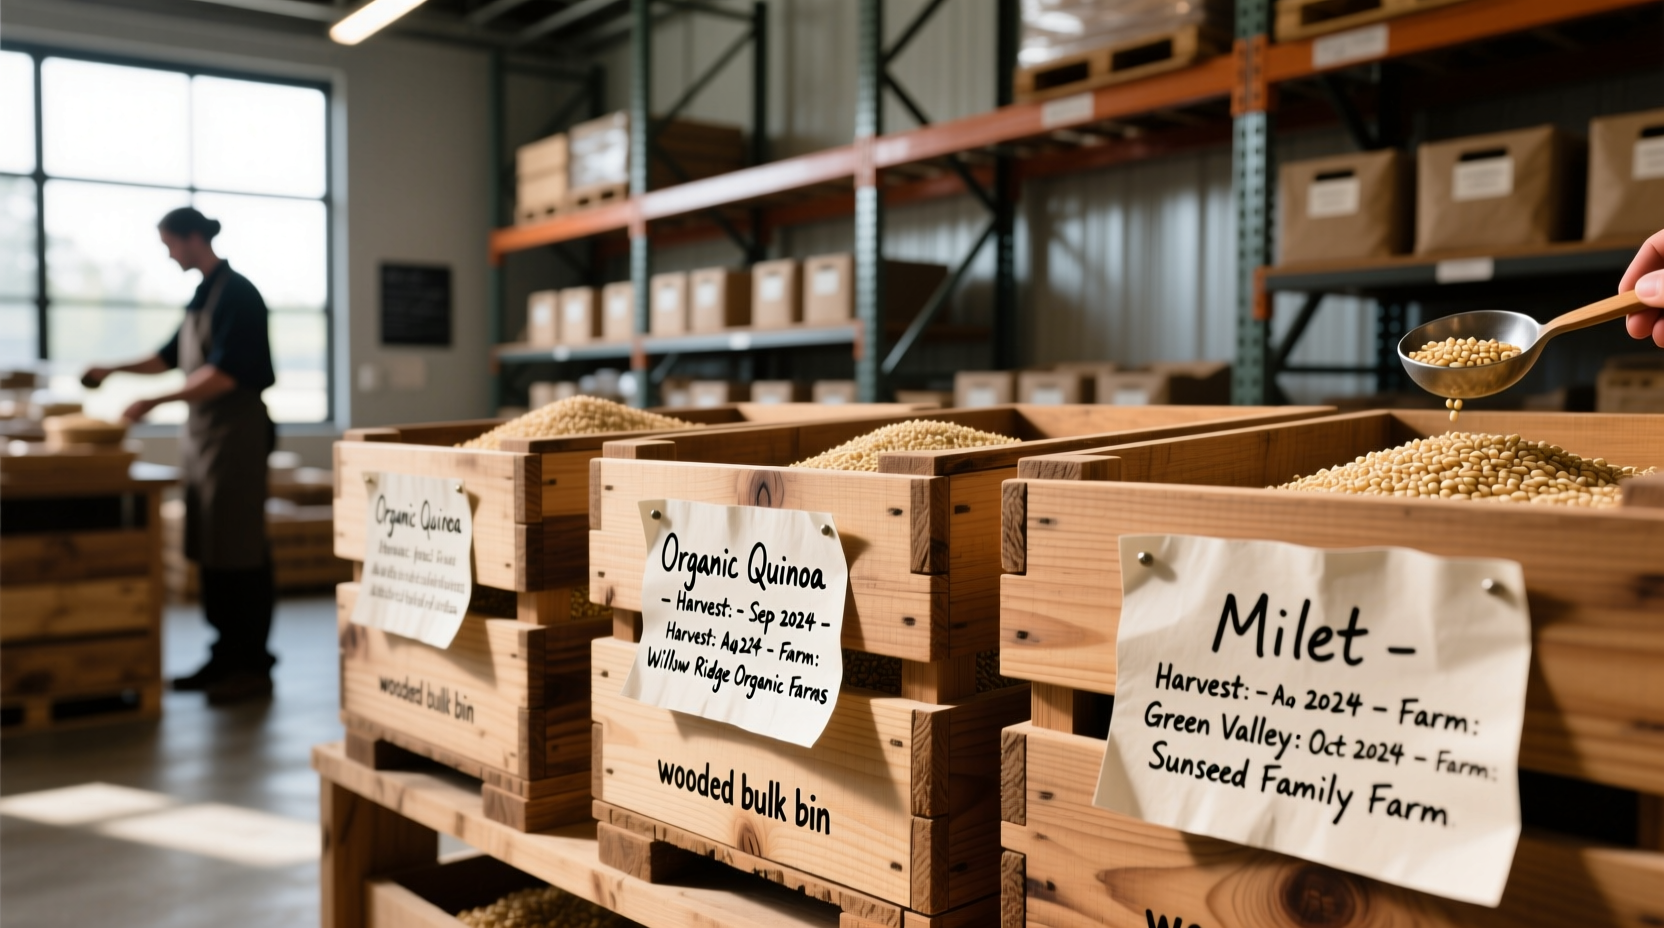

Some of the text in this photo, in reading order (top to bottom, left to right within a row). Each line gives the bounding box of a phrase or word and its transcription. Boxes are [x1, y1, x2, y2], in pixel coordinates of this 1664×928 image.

[375, 494, 416, 538] Organic
[661, 532, 827, 592] Organic Quinoa
[676, 589, 732, 618] Harvest:
[748, 600, 776, 635] Sep
[779, 609, 817, 632] 2024
[1211, 592, 1370, 667] Milet
[665, 620, 716, 647] Harvest:
[778, 641, 819, 667] Farm:
[454, 690, 475, 724] bin
[694, 655, 731, 693] Ridge
[734, 664, 784, 700] Organic
[1155, 661, 1250, 701] Harvest:
[1303, 689, 1364, 717] 2024
[1399, 698, 1480, 736] Farm:
[1144, 700, 1210, 736] Green
[1221, 712, 1302, 761] Valley:
[1308, 728, 1347, 758] Oct
[1352, 739, 1405, 766] 2024
[657, 759, 831, 836] wooded bulk bin
[1148, 740, 1450, 827] Sunseed Family Farm
